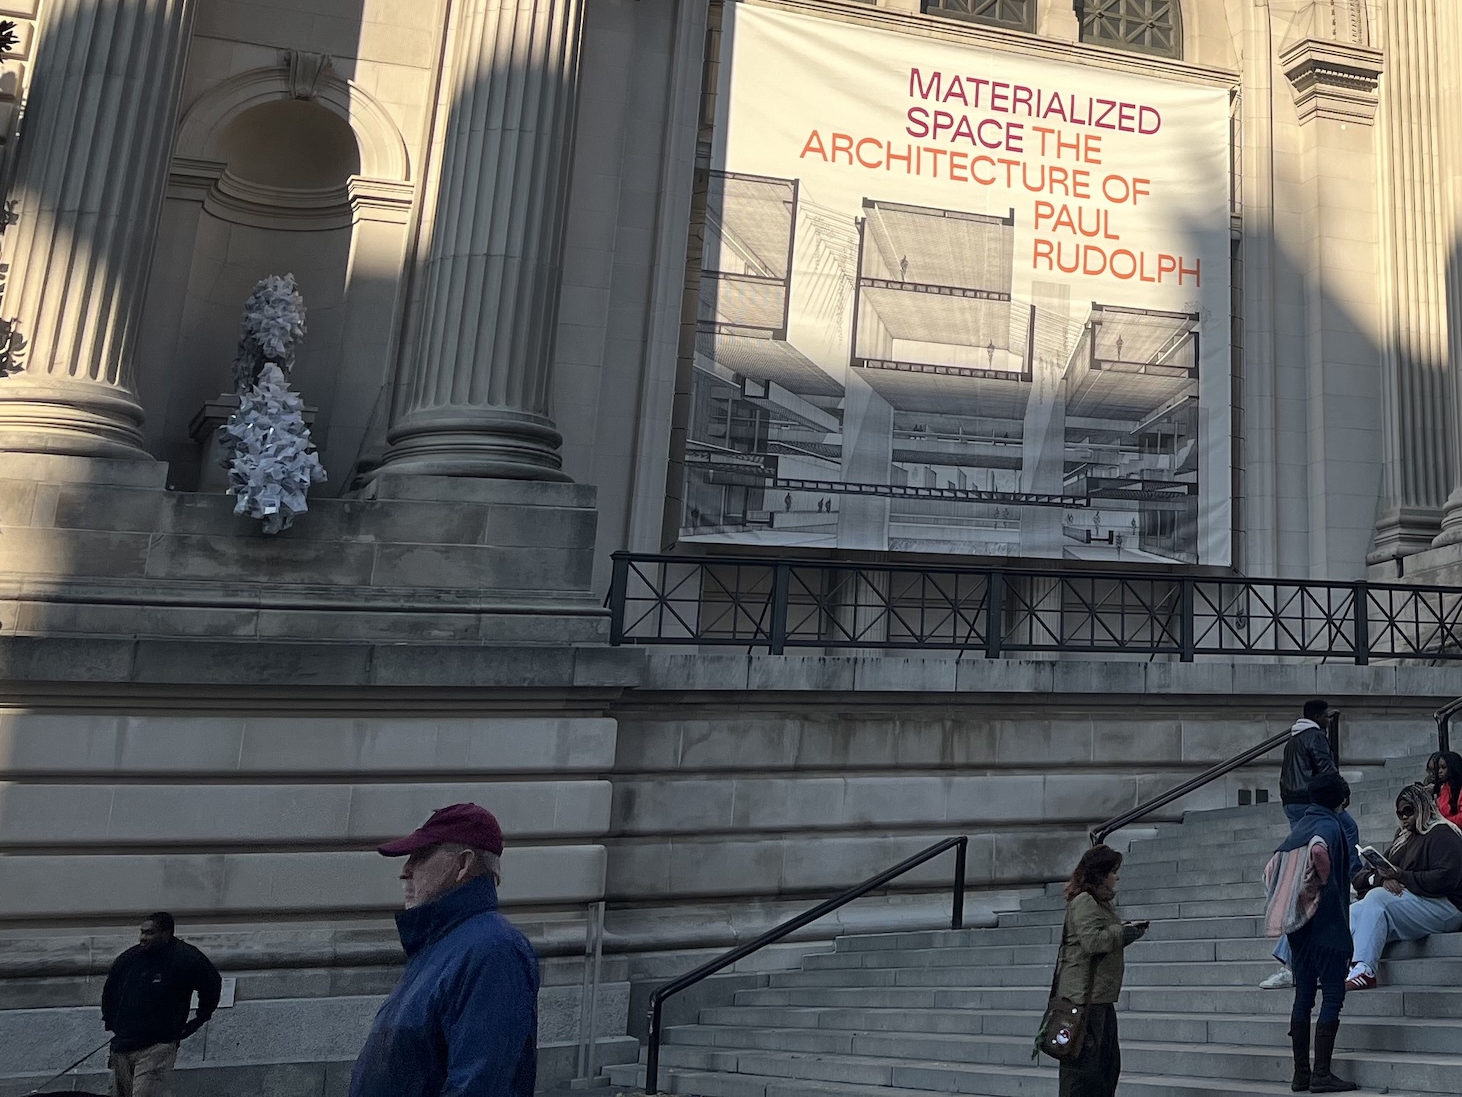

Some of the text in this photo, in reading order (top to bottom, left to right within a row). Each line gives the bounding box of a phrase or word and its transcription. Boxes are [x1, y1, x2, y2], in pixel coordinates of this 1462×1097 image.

[909, 67, 1162, 135] MATERIALIZED
[905, 106, 1102, 165] SPACE THE
[799, 129, 1150, 206] ARCHITECTURE OF
[1034, 200, 1120, 241] PAUL
[1032, 238, 1201, 289] RUDOLPH
